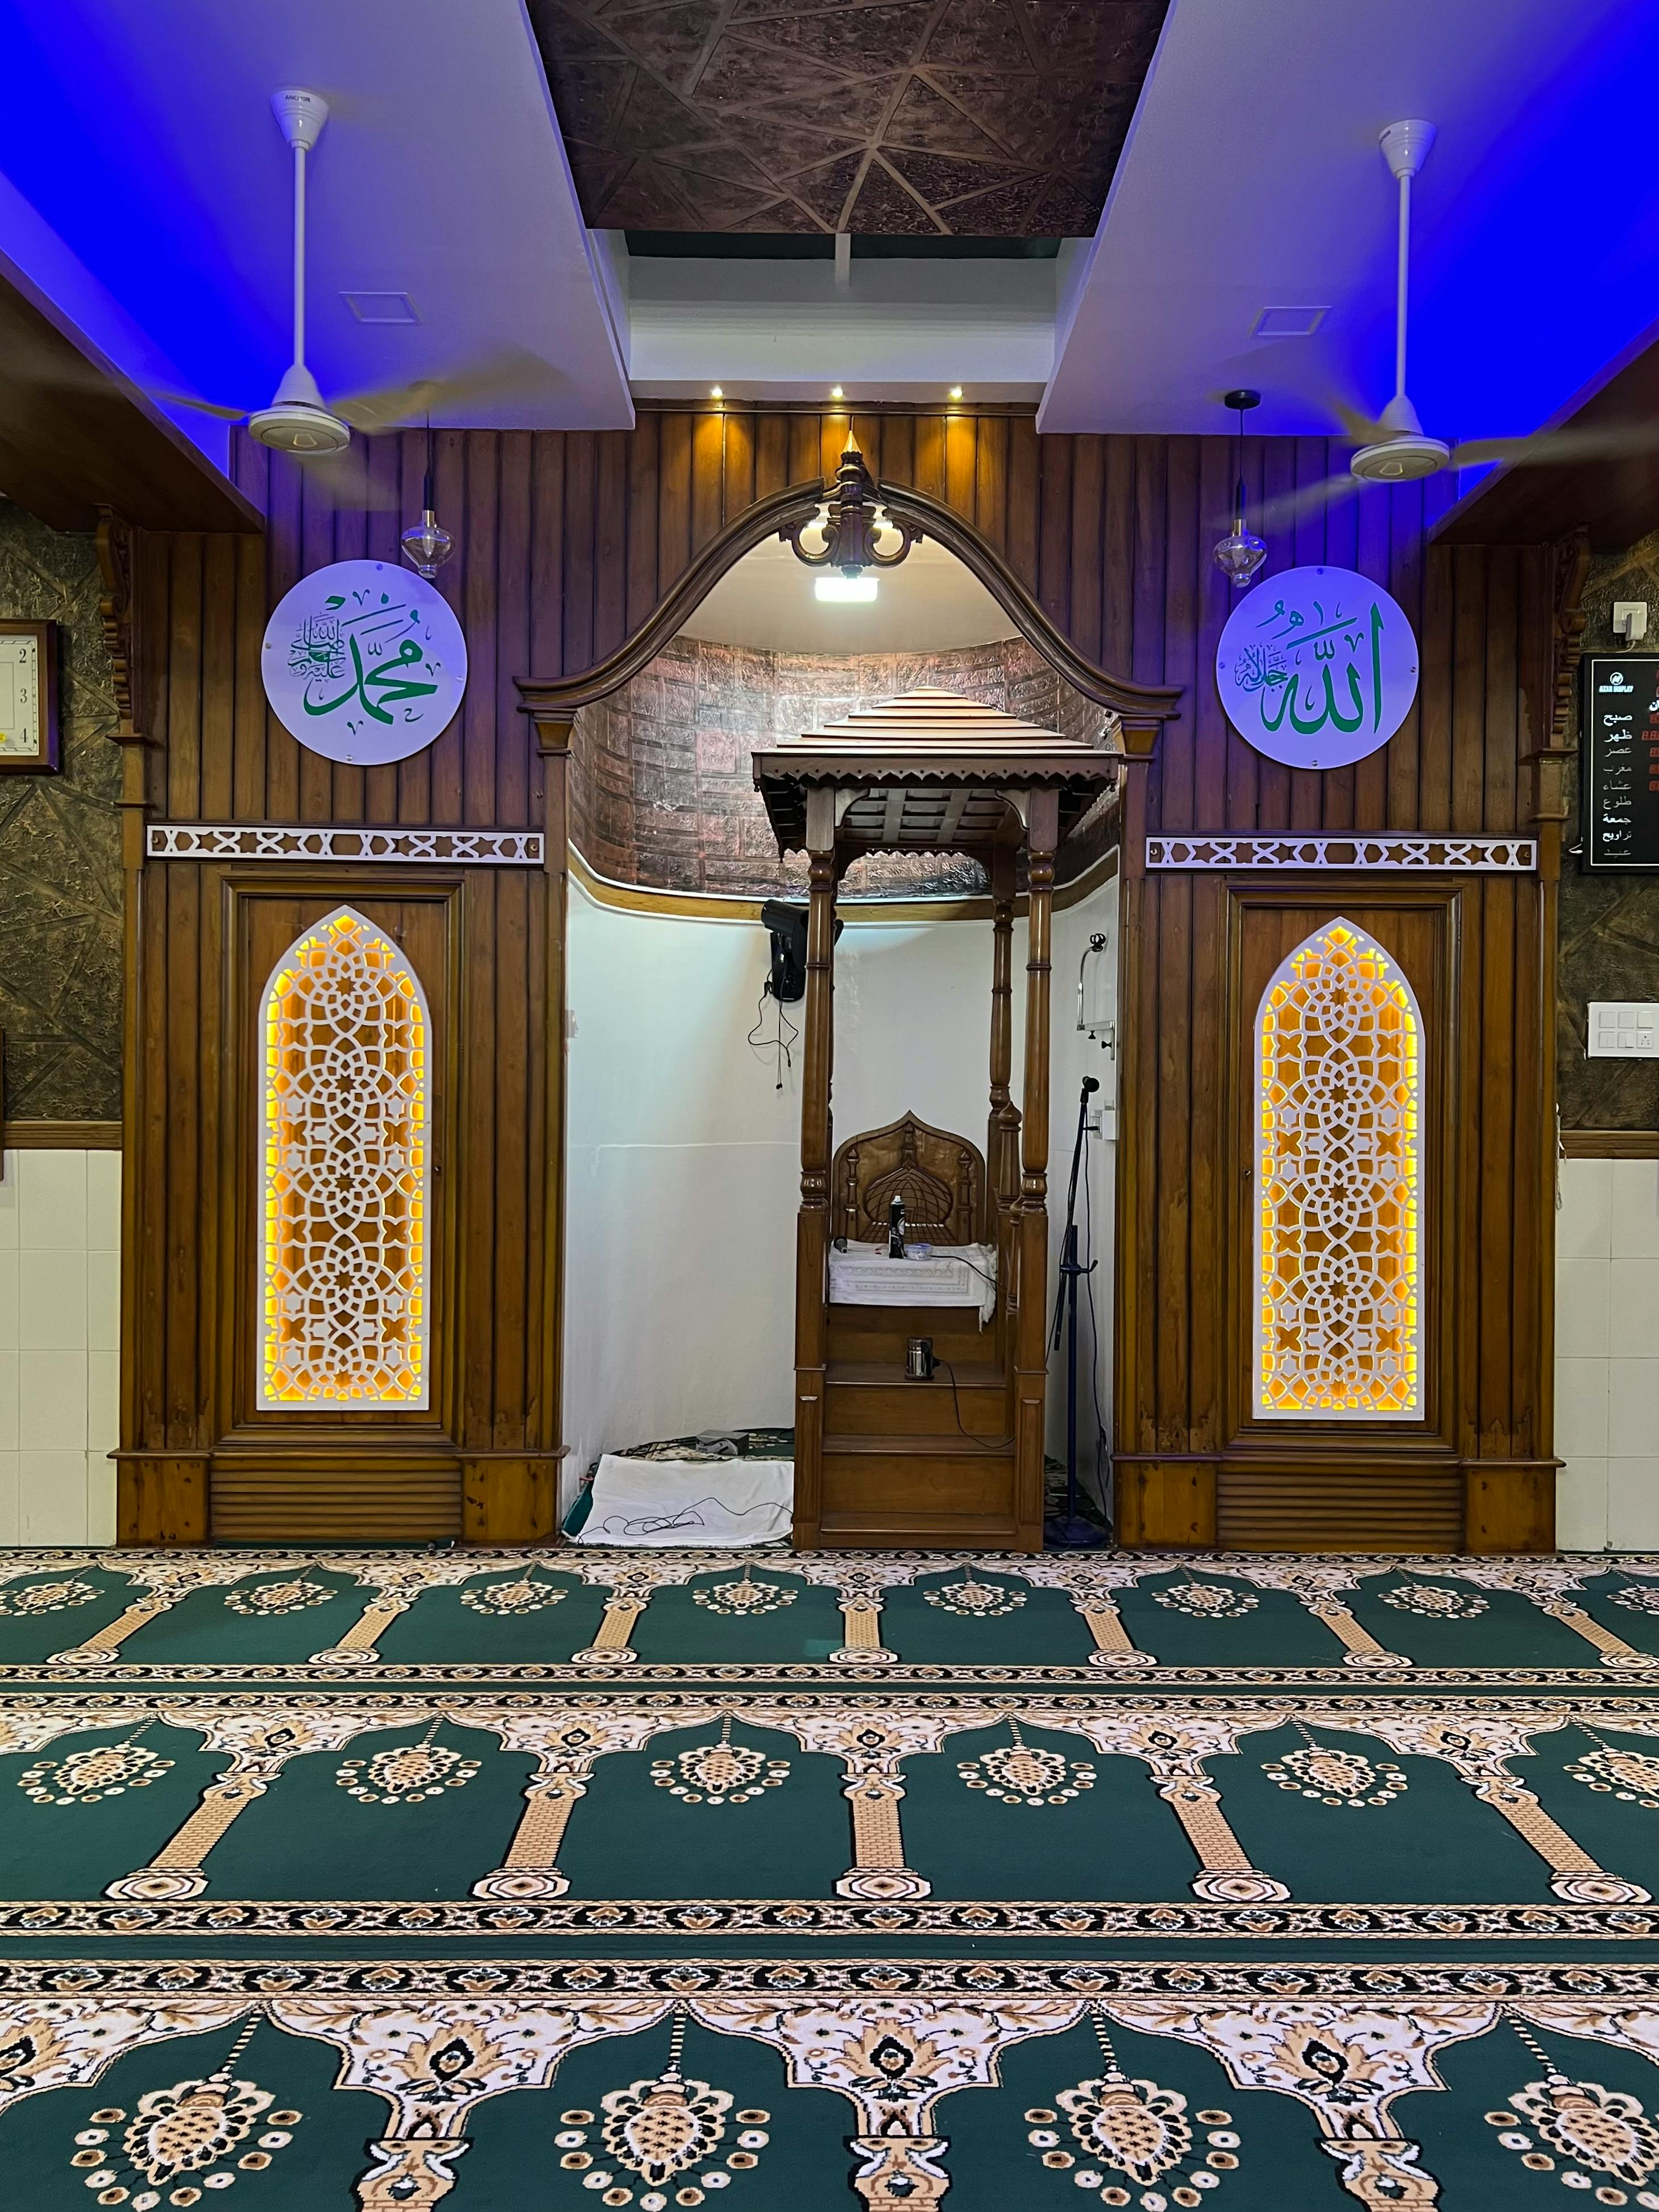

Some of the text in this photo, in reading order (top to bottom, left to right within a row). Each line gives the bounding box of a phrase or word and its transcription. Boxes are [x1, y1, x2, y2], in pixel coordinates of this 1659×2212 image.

[19, 648, 27, 664] 2
[20, 688, 27, 703] 3
[1603, 714, 1633, 726] صبح
[20, 728, 28, 743] 4
[1604, 729, 1632, 743] ظهر
[1604, 747, 1632, 757] عصر
[1603, 764, 1632, 775] مغرب
[1603, 780, 1632, 790] عشاء
[1603, 796, 1632, 810] طلوع
[1603, 813, 1632, 825] جمعة
